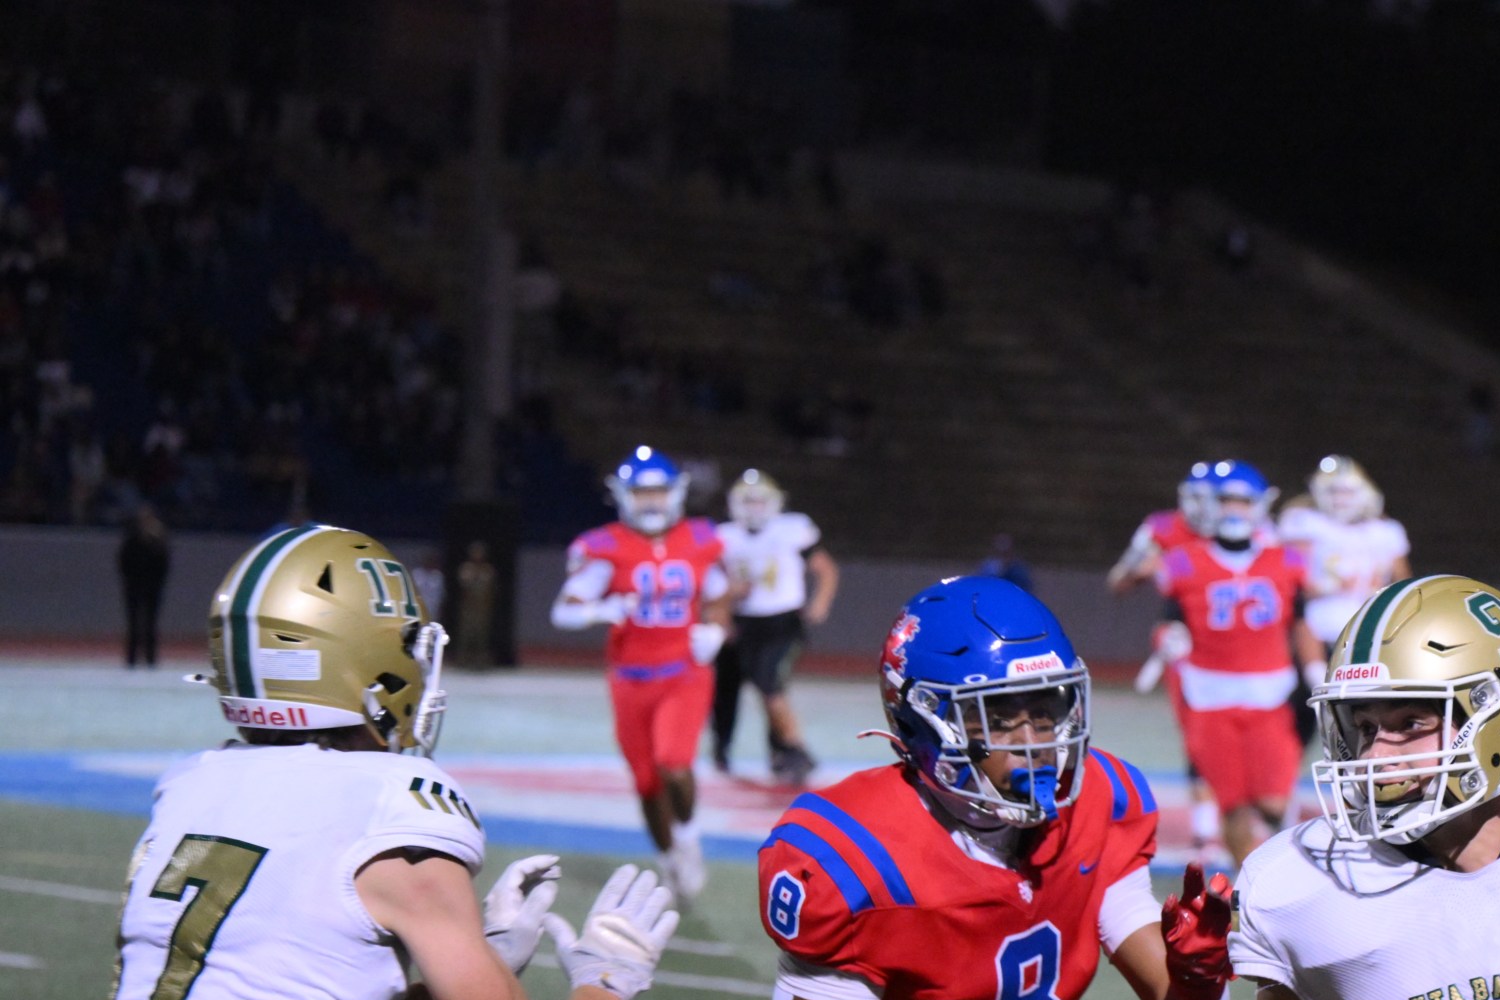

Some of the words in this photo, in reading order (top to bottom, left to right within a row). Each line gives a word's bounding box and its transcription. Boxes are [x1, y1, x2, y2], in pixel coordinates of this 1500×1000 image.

[356, 557, 421, 621] 17
[631, 559, 695, 628] 12
[1015, 656, 1059, 674] Riddell
[1335, 665, 1379, 682] Riddell
[767, 870, 806, 941] 8
